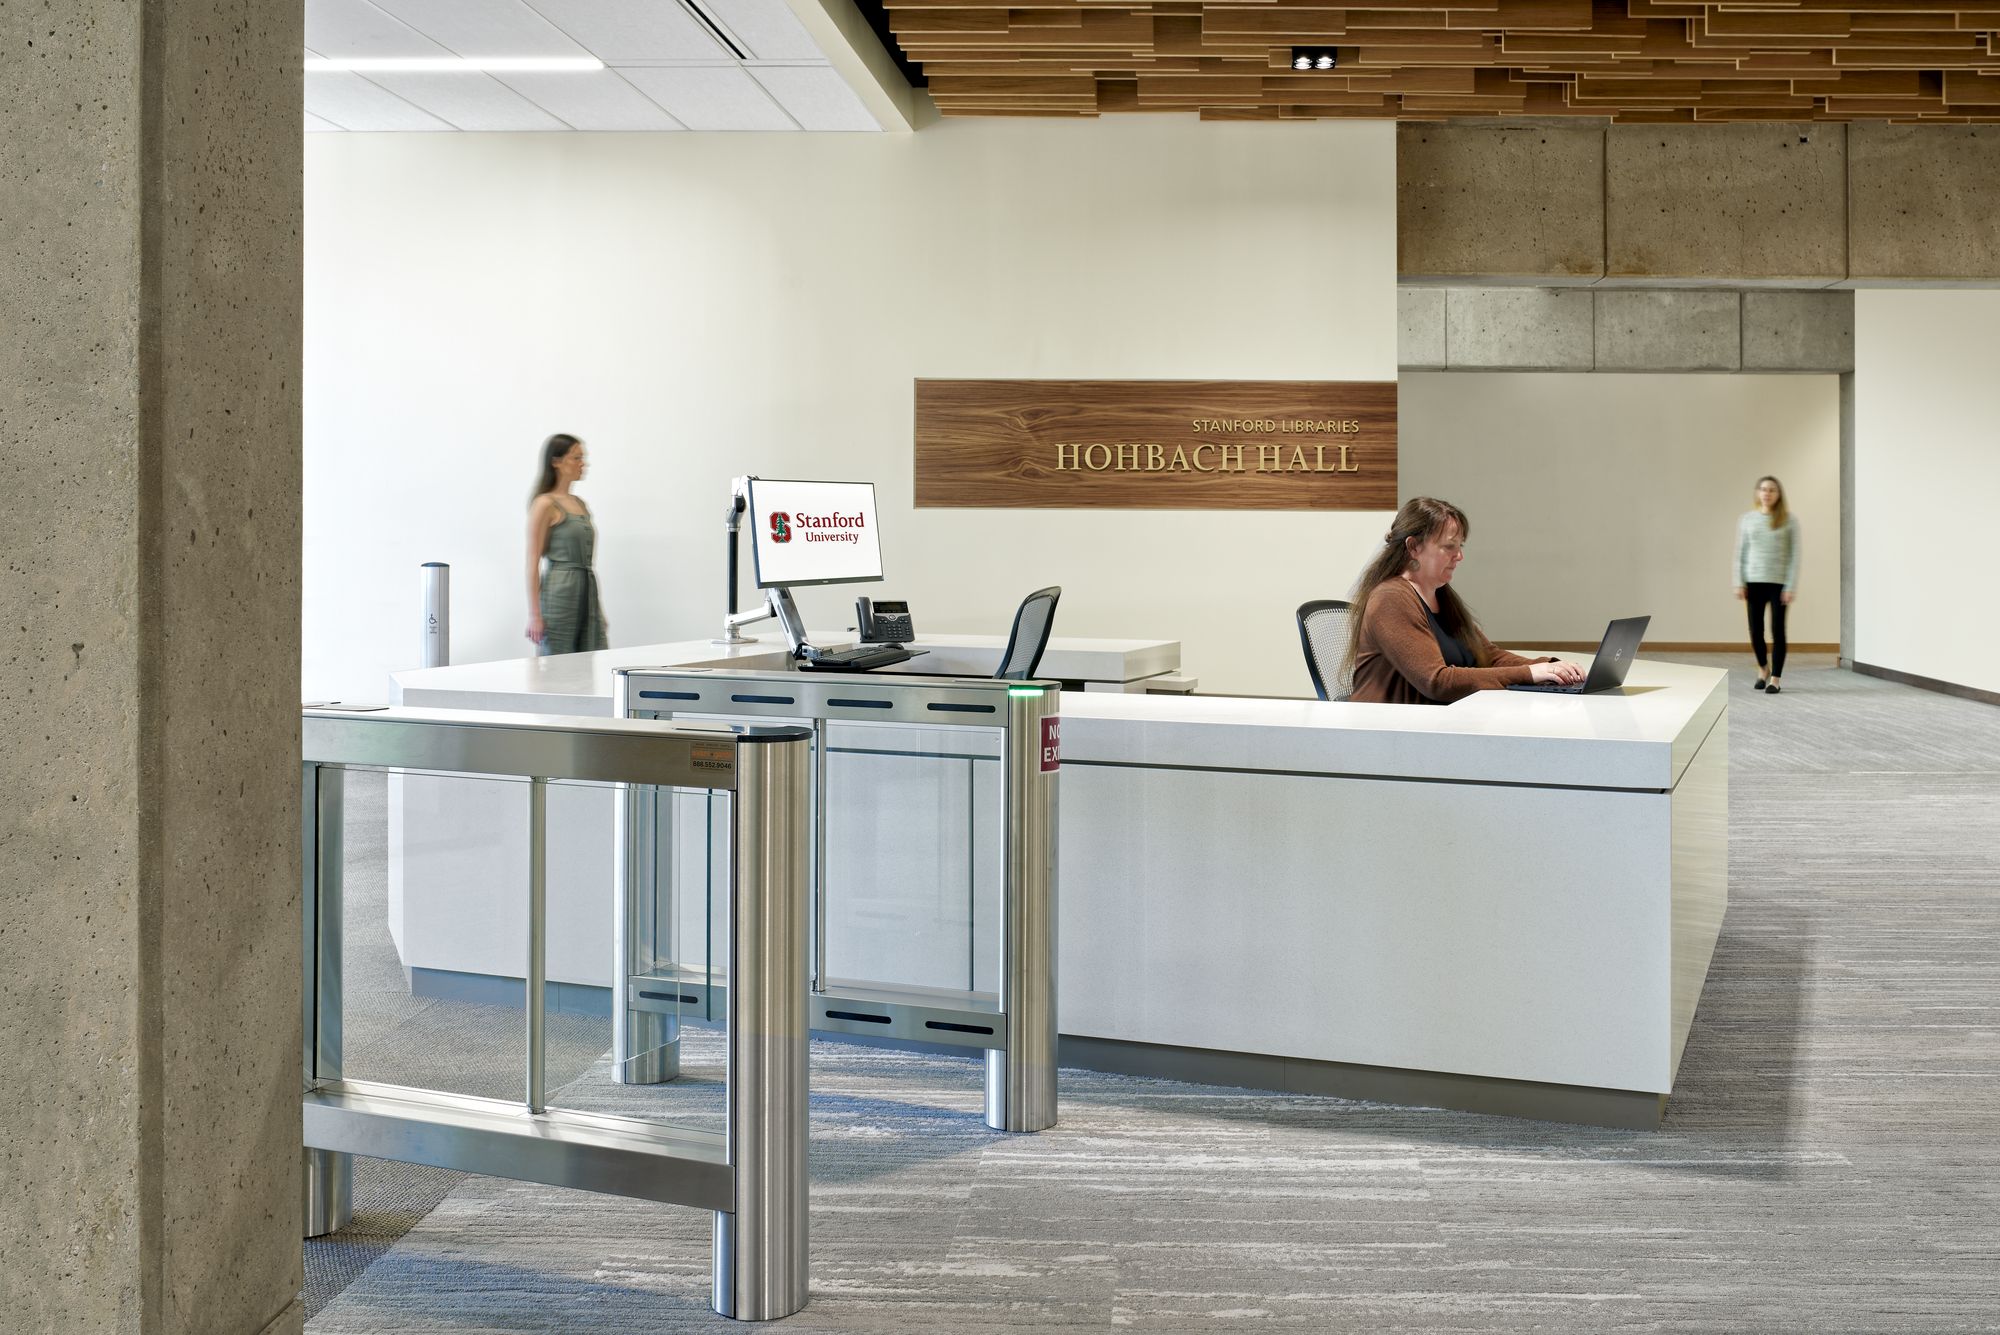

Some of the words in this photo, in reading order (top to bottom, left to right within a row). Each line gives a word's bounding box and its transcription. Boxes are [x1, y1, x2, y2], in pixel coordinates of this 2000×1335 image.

[1192, 419, 1276, 433] STANFORD
[1282, 419, 1360, 433] LIBRARIES
[1055, 443, 1247, 472] HOHBACH
[1255, 444, 1360, 473] HALL
[796, 512, 865, 528] Stanford
[805, 531, 859, 544] University
[1043, 746, 1060, 762] EXI
